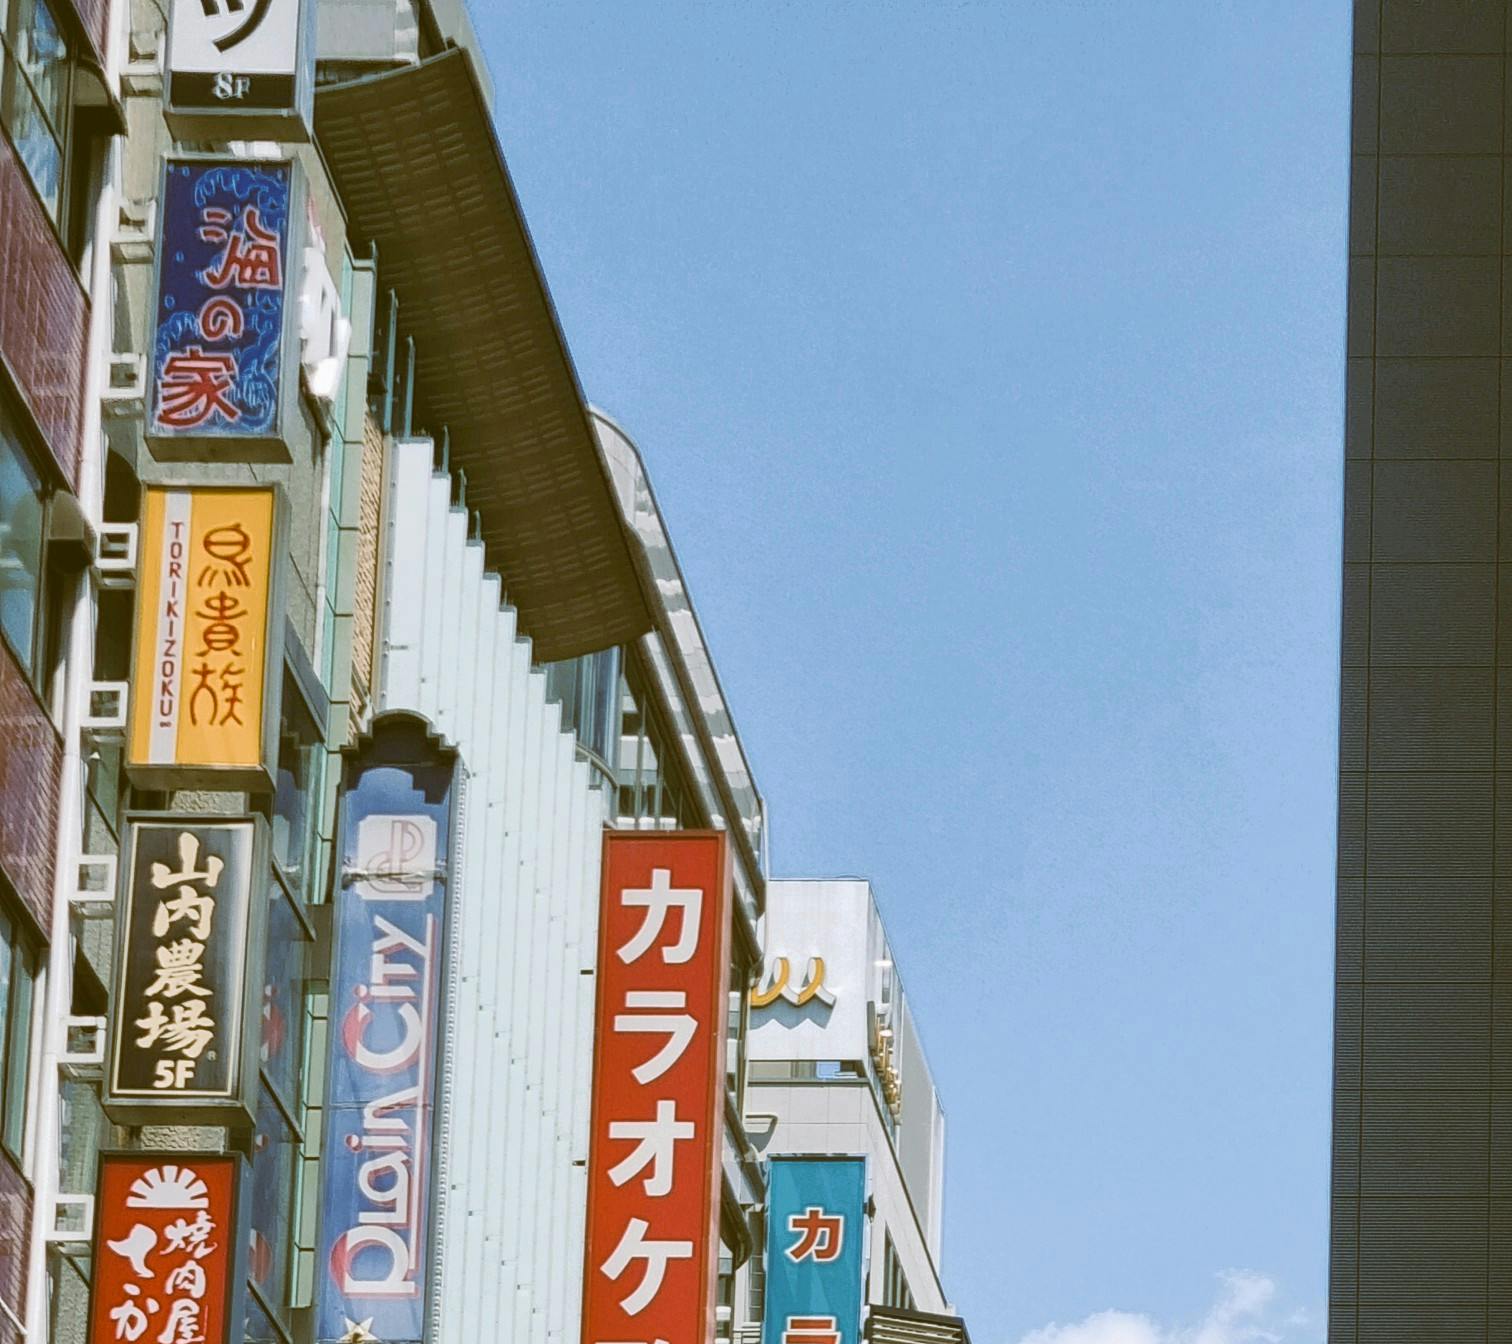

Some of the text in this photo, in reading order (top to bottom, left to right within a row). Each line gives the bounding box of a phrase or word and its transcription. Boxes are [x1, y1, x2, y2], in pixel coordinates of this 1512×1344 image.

[211, 71, 251, 101] 8F
[155, 205, 284, 430] 海の家
[159, 521, 185, 718] TORIKIZOKU
[135, 832, 225, 1060] 山内農場
[153, 1060, 196, 1089] 5F
